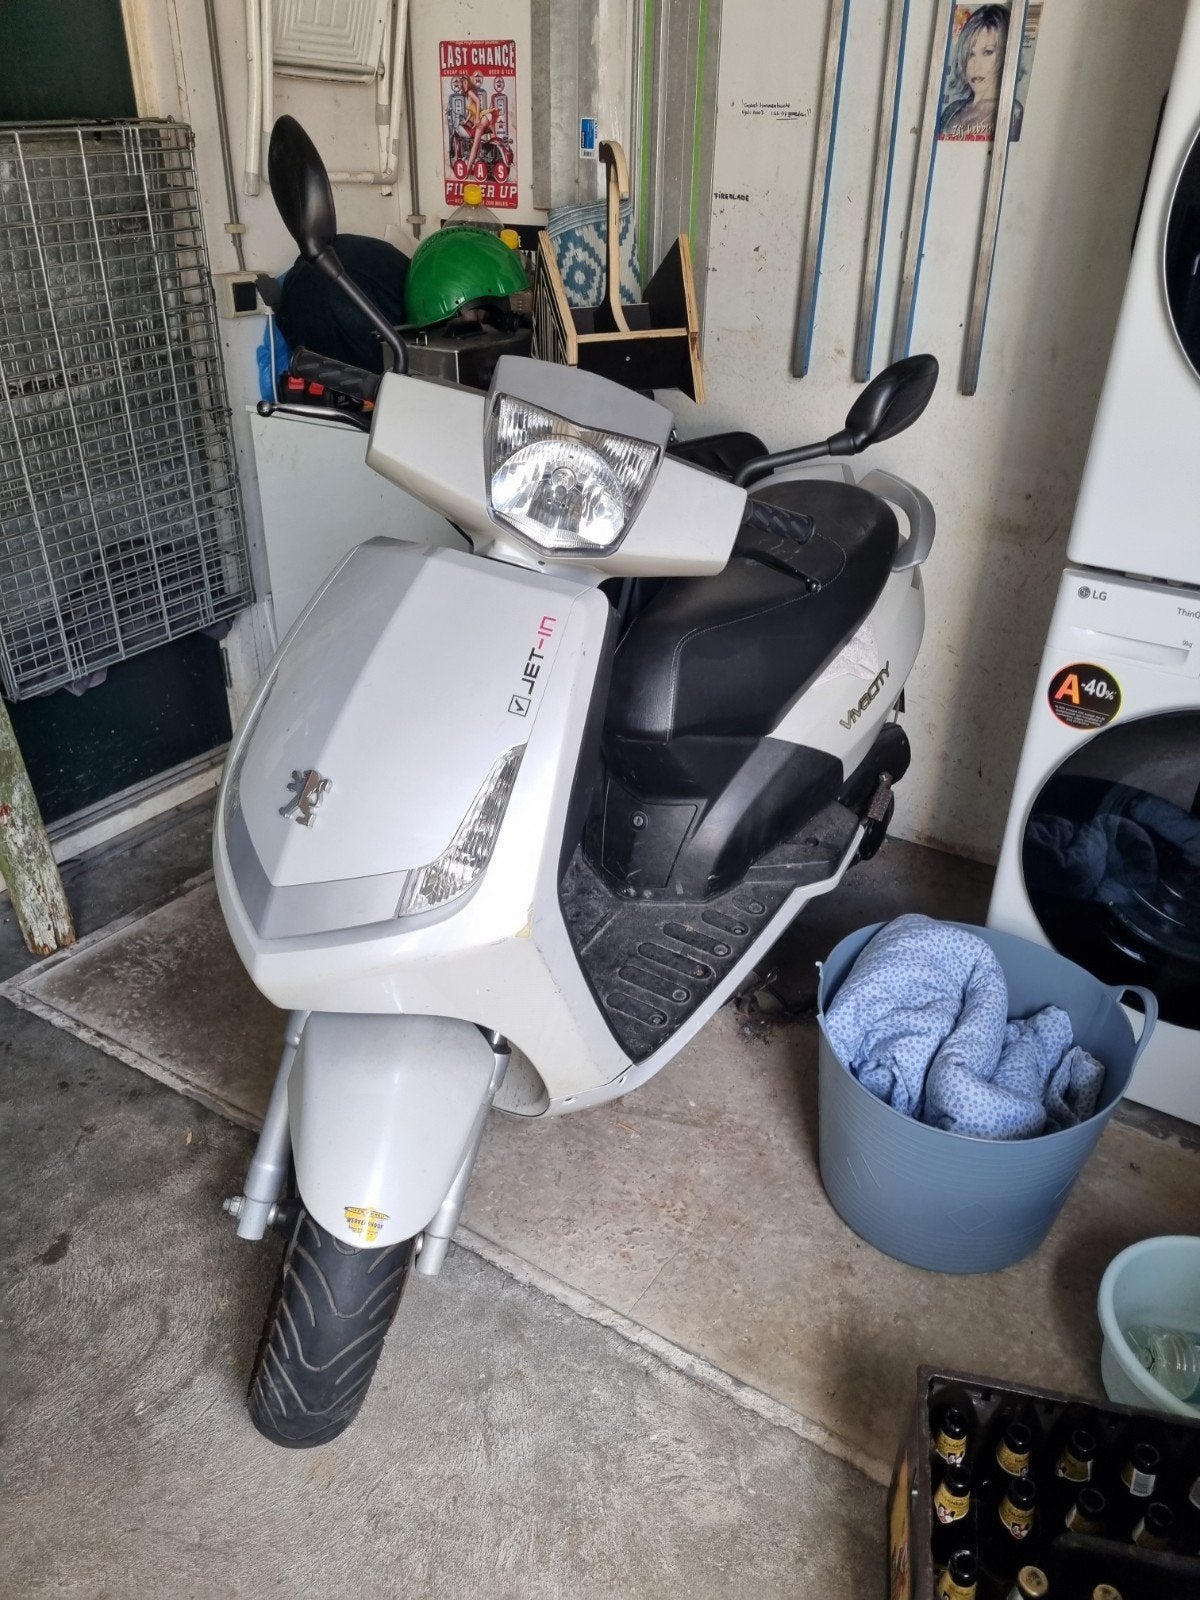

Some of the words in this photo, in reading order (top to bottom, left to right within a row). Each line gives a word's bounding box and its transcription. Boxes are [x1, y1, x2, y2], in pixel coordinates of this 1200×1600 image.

[441, 44, 468, 69] LAST
[471, 42, 515, 69] CHANCE
[500, 185, 517, 199] UP
[1092, 589, 1107, 601] LG
[1177, 607, 1200, 619] ThinQ
[1054, 673, 1080, 705] A
